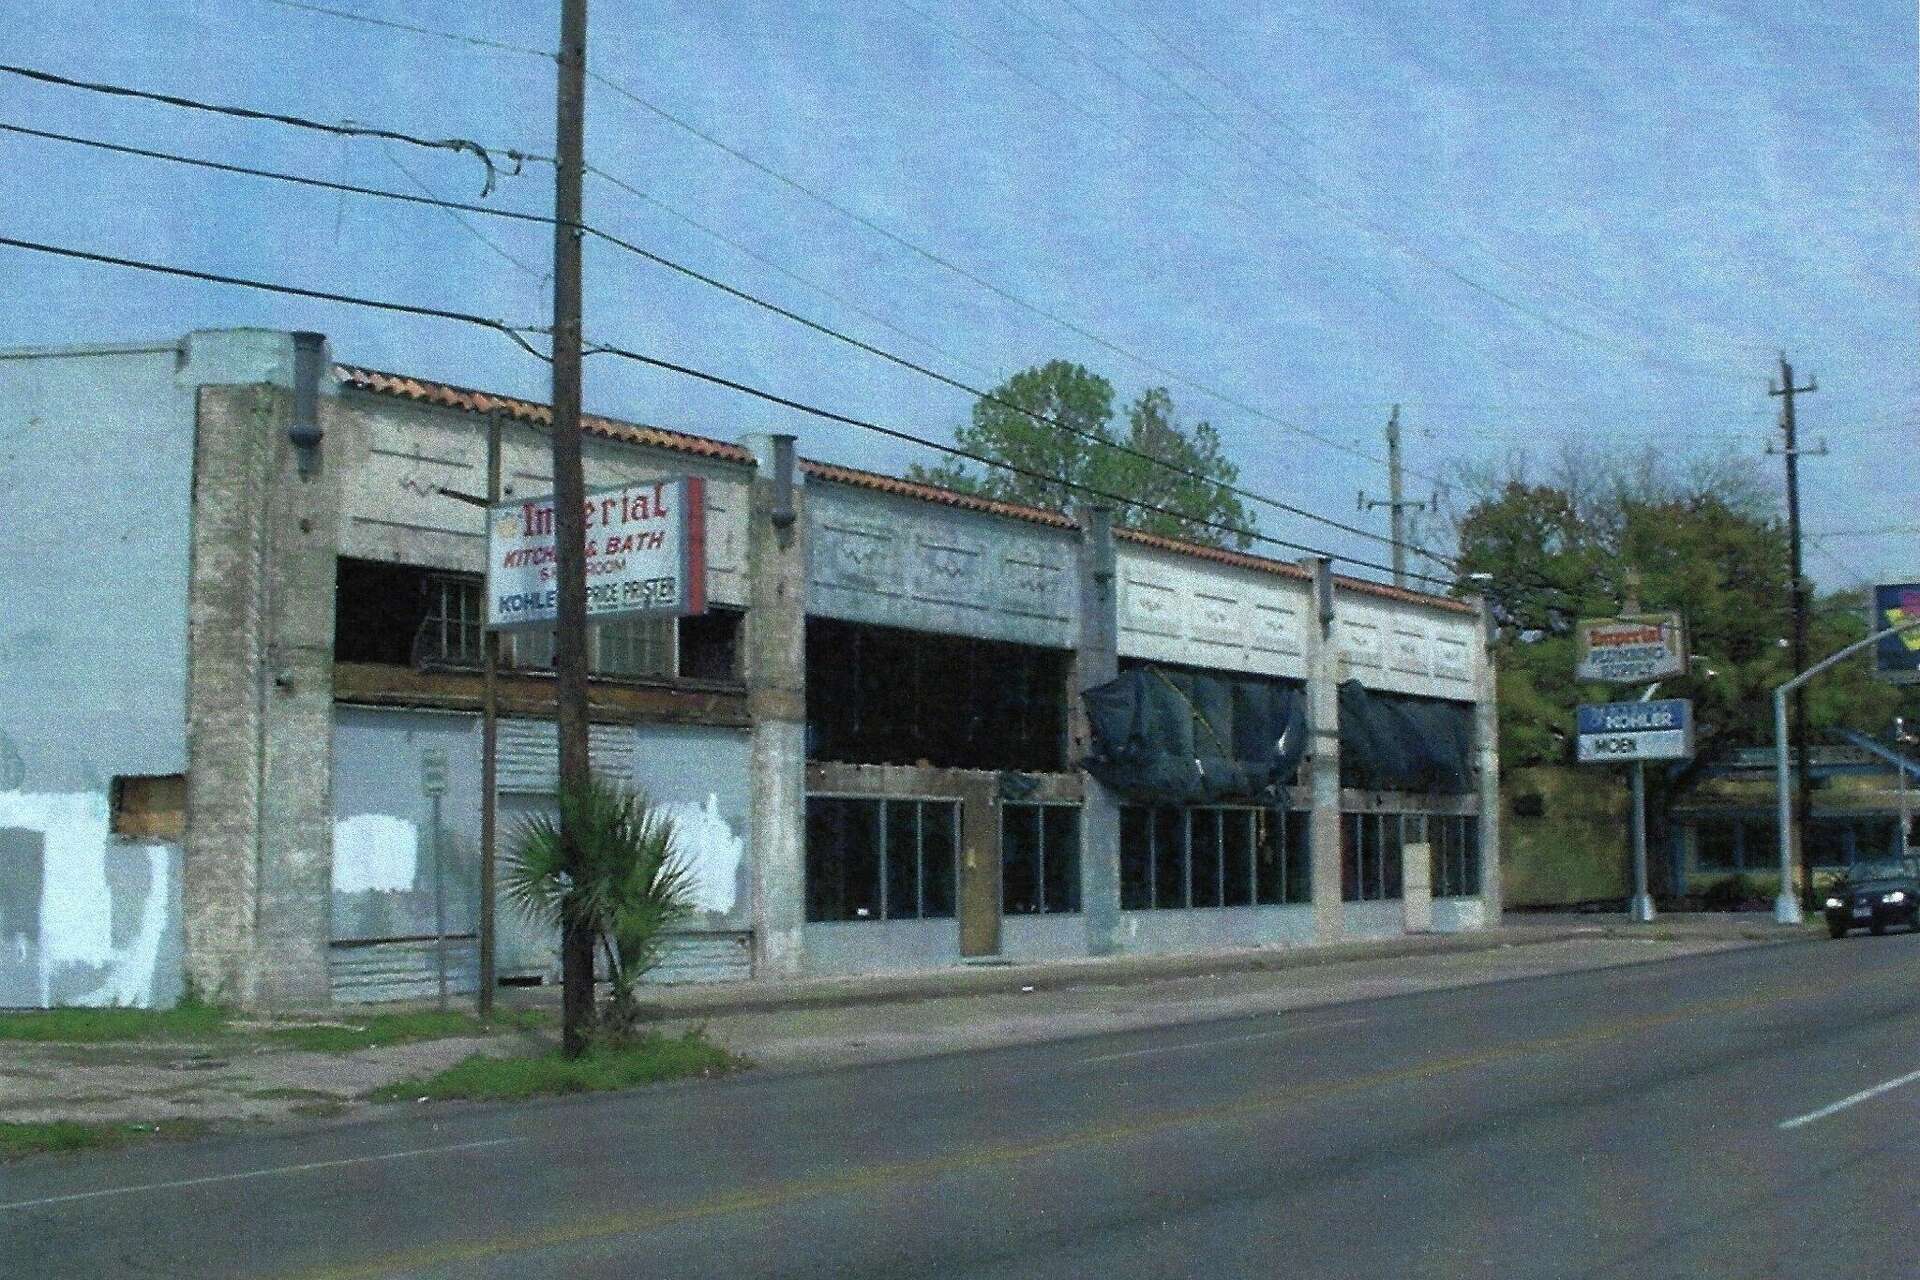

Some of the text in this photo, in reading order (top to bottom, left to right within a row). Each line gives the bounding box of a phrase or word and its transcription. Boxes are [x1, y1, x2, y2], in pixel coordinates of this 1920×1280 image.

[523, 483, 667, 537] Imerial
[606, 532, 666, 555] BATH
[499, 590, 558, 613] KOHLE
[1606, 713, 1672, 729] KOHLER
[1594, 738, 1637, 753] MOEN
